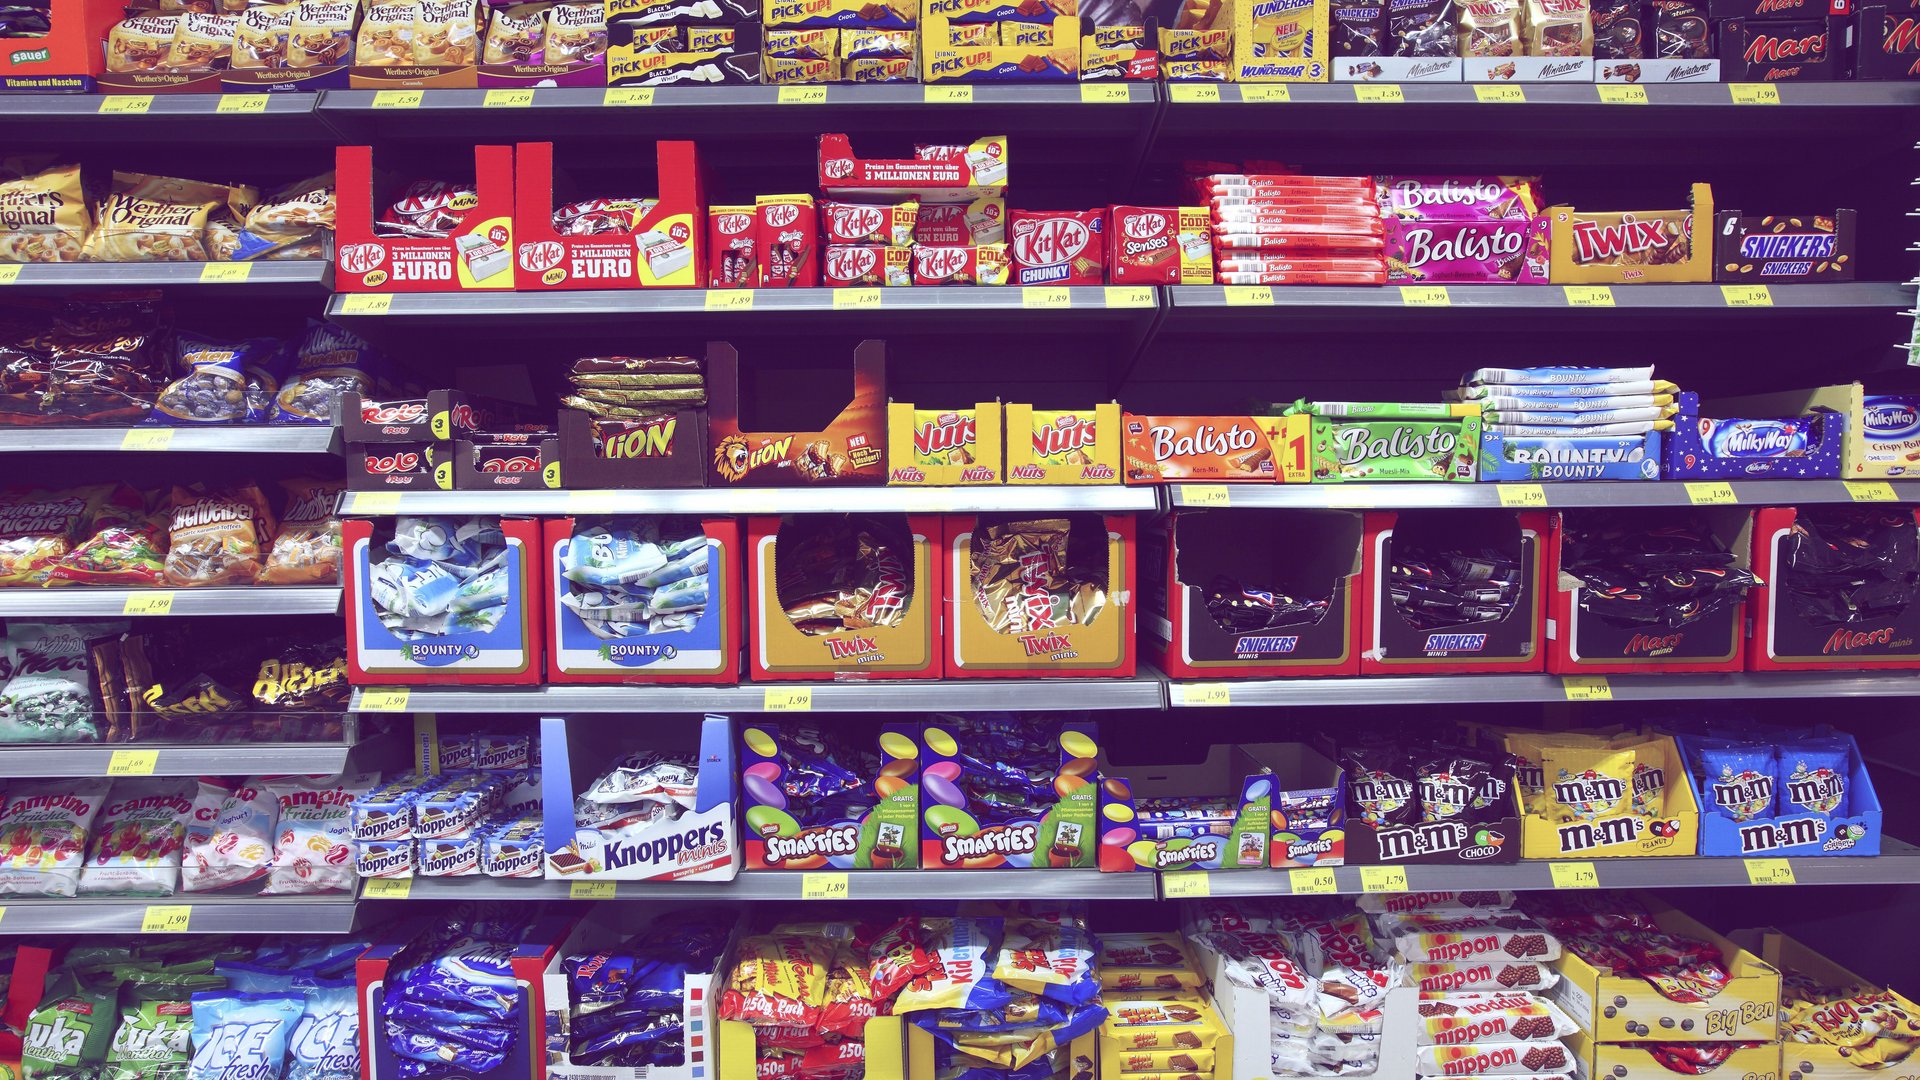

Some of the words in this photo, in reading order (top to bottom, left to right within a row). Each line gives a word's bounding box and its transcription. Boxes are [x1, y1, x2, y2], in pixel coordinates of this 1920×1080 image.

[557, 14, 604, 26] Original
[1335, 8, 1380, 19] SNICKERS
[1275, 22, 1298, 35] NEU
[800, 30, 824, 44] UP!
[1201, 29, 1227, 44] UP!
[1743, 33, 1827, 63] Mars
[12, 49, 48, 62] sauer
[642, 55, 667, 70] UP!
[965, 50, 993, 67] UP!
[385, 67, 413, 76] Werther's
[415, 67, 440, 76] Original
[513, 64, 541, 73] Werther's
[542, 64, 568, 74] Original
[805, 61, 831, 75] UP!
[887, 60, 911, 75] UP!
[1241, 65, 1304, 78] WUNDERBAR
[1309, 63, 1320, 77] 3
[1406, 61, 1452, 78] Miniatures
[1538, 60, 1584, 79] Miniatures
[1666, 62, 1712, 81] Miniatures
[1764, 66, 1801, 80] Mars
[134, 74, 161, 83] Werther's
[163, 75, 188, 83] Original
[255, 71, 283, 80] Werther's
[285, 70, 310, 79] Original
[5, 78, 36, 87] Vitamine
[38, 78, 51, 87] und
[52, 78, 82, 87] Naschen
[629, 93, 650, 101] 1.89
[803, 92, 824, 100] 1.89
[948, 90, 969, 98] 1.89
[1106, 90, 1127, 98] 2.99
[1196, 90, 1216, 98] 2.99
[1266, 89, 1286, 97] 1.79
[1381, 90, 1401, 98] 1.39
[1501, 90, 1520, 98] 1.39
[1625, 91, 1645, 99] 1.39
[1756, 91, 1776, 99] 1.99
[945, 162, 959, 171] über
[874, 171, 930, 181] MILLIONEN
[932, 171, 959, 181] EURO
[1396, 180, 1501, 210] Balisto
[111, 206, 192, 228] Original
[771, 204, 798, 226] KitKat
[844, 206, 882, 236] KitKat
[1181, 216, 1210, 227] CODE
[724, 214, 750, 234] KitKat
[1126, 236, 1168, 254] senses
[1264, 237, 1287, 246] Balisto
[1405, 226, 1521, 269] Balisto
[1743, 235, 1835, 258] SNICKERS
[392, 251, 398, 260] 3
[400, 250, 451, 260] MILLIONEN
[579, 248, 631, 258] MILLIONEN
[392, 261, 452, 280] EURO
[571, 258, 632, 278] EURO
[835, 249, 873, 279] KitKat
[924, 249, 965, 278] KitKat
[1269, 262, 1293, 272] Balisto
[1762, 261, 1812, 275] SNICKERS
[1022, 265, 1069, 282] CHUNKY
[1550, 373, 1586, 383] BOUNTY
[435, 418, 443, 429] 3
[1701, 420, 1711, 437] 9
[850, 436, 866, 447] NEU
[1151, 423, 1256, 462] Balisto
[1340, 427, 1455, 465] Balisto
[365, 453, 418, 473] Rolo
[1685, 455, 1696, 469] 9
[1856, 463, 1863, 472] 6
[437, 469, 446, 480] 3
[546, 469, 555, 480] 3
[891, 469, 925, 482] Nuts
[960, 468, 995, 482] Nuts
[1010, 466, 1046, 479] Nuts
[1080, 466, 1115, 479] Nuts
[1192, 466, 1219, 474] Korn-Mix
[1379, 467, 1410, 476] Muesli-Mix
[1542, 464, 1605, 478] BOUNTY
[1524, 492, 1543, 500] 1.99
[1712, 490, 1731, 499] 1.99
[149, 599, 169, 608] 1.99
[1237, 637, 1298, 653] SNICKERS
[1426, 635, 1486, 651] SNICKERS
[1624, 632, 1684, 655] Mars
[1823, 627, 1894, 654] Mars
[412, 644, 462, 655] BOUNTY
[610, 644, 660, 656] BOUNTY
[1051, 650, 1078, 661] minis
[857, 653, 885, 664] minis
[1589, 684, 1607, 694] 1.99
[385, 697, 405, 706] 1.99
[788, 696, 808, 705] 1.99
[1554, 778, 1627, 804] m&m's
[1, 792, 90, 818] campino
[108, 793, 193, 816] campino
[220, 811, 249, 825] Joghurt
[1379, 823, 1468, 860] m&m's
[1558, 817, 1644, 852] m&m's
[1741, 818, 1826, 853] m&m's
[604, 821, 724, 872] Knoppers
[1641, 838, 1667, 849] PEANUT
[677, 839, 728, 866] minis
[1385, 875, 1404, 885] 1.79
[1575, 872, 1593, 881] 1.79
[1772, 868, 1790, 878] 1.79
[589, 882, 605, 890] 2.19
[826, 883, 845, 892] 1.89
[1314, 876, 1333, 886] 0.50
[1386, 890, 1453, 912] nippon
[167, 914, 187, 925] 1.99
[1429, 934, 1499, 962] nippon
[1421, 966, 1492, 991] nippon
[850, 1003, 877, 1017] 250g
[1812, 1001, 1852, 1032] Big
[1706, 1006, 1739, 1037] Big
[1740, 1000, 1776, 1025] Ben
[1435, 1017, 1506, 1044] nippon
[194, 1021, 284, 1070] ICE
[1444, 1046, 1517, 1075] nippon
[219, 1057, 270, 1080] fresh
[756, 1060, 785, 1077] 250g
